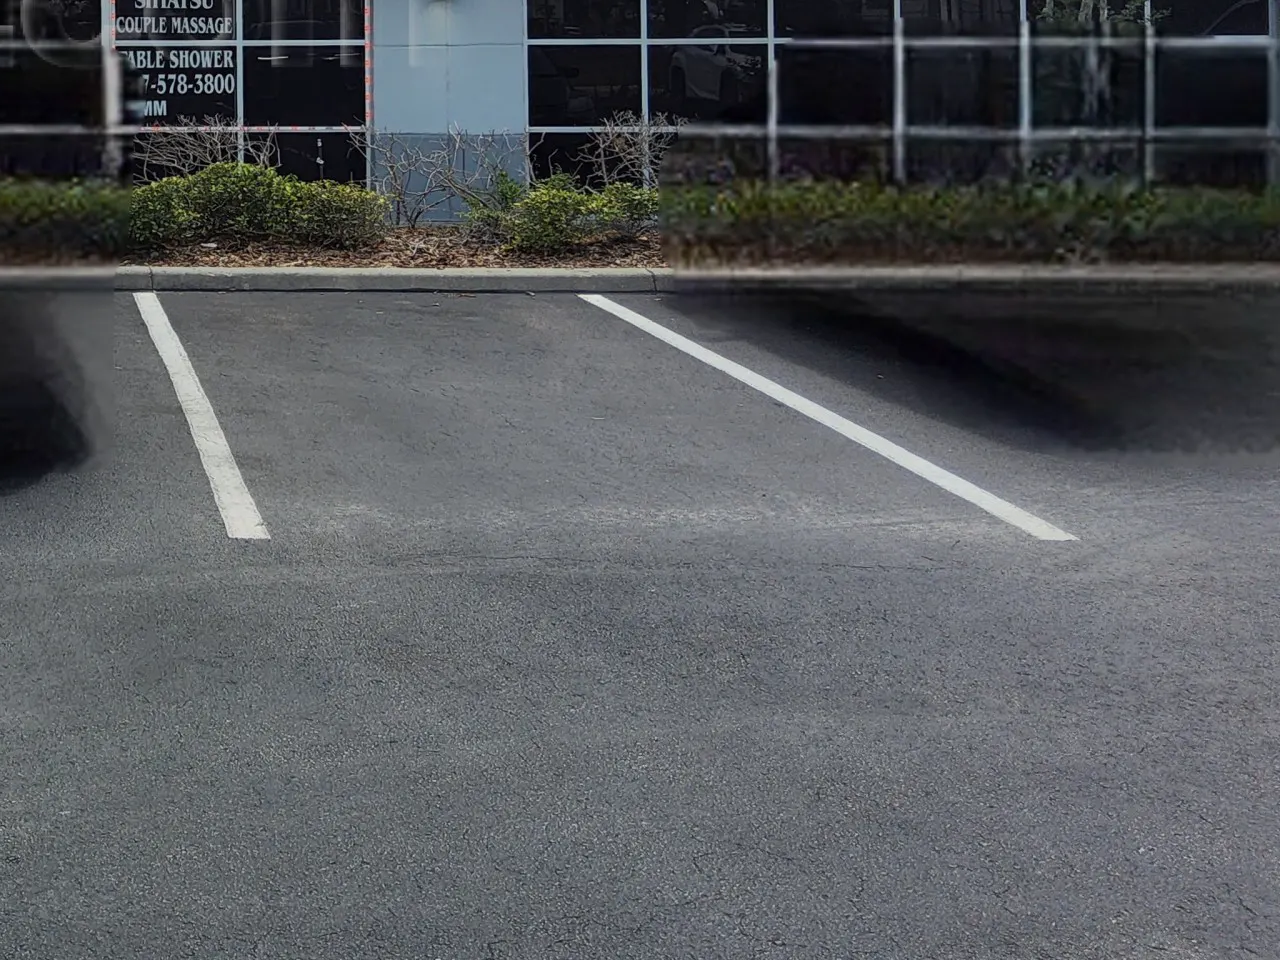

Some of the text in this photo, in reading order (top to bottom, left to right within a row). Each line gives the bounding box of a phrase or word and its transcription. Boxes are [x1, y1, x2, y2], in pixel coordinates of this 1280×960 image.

[116, 16, 233, 34] COUPLE MASSAGE
[119, 50, 234, 68] ABLE SHOWER
[143, 73, 236, 95] 7-578-3800
